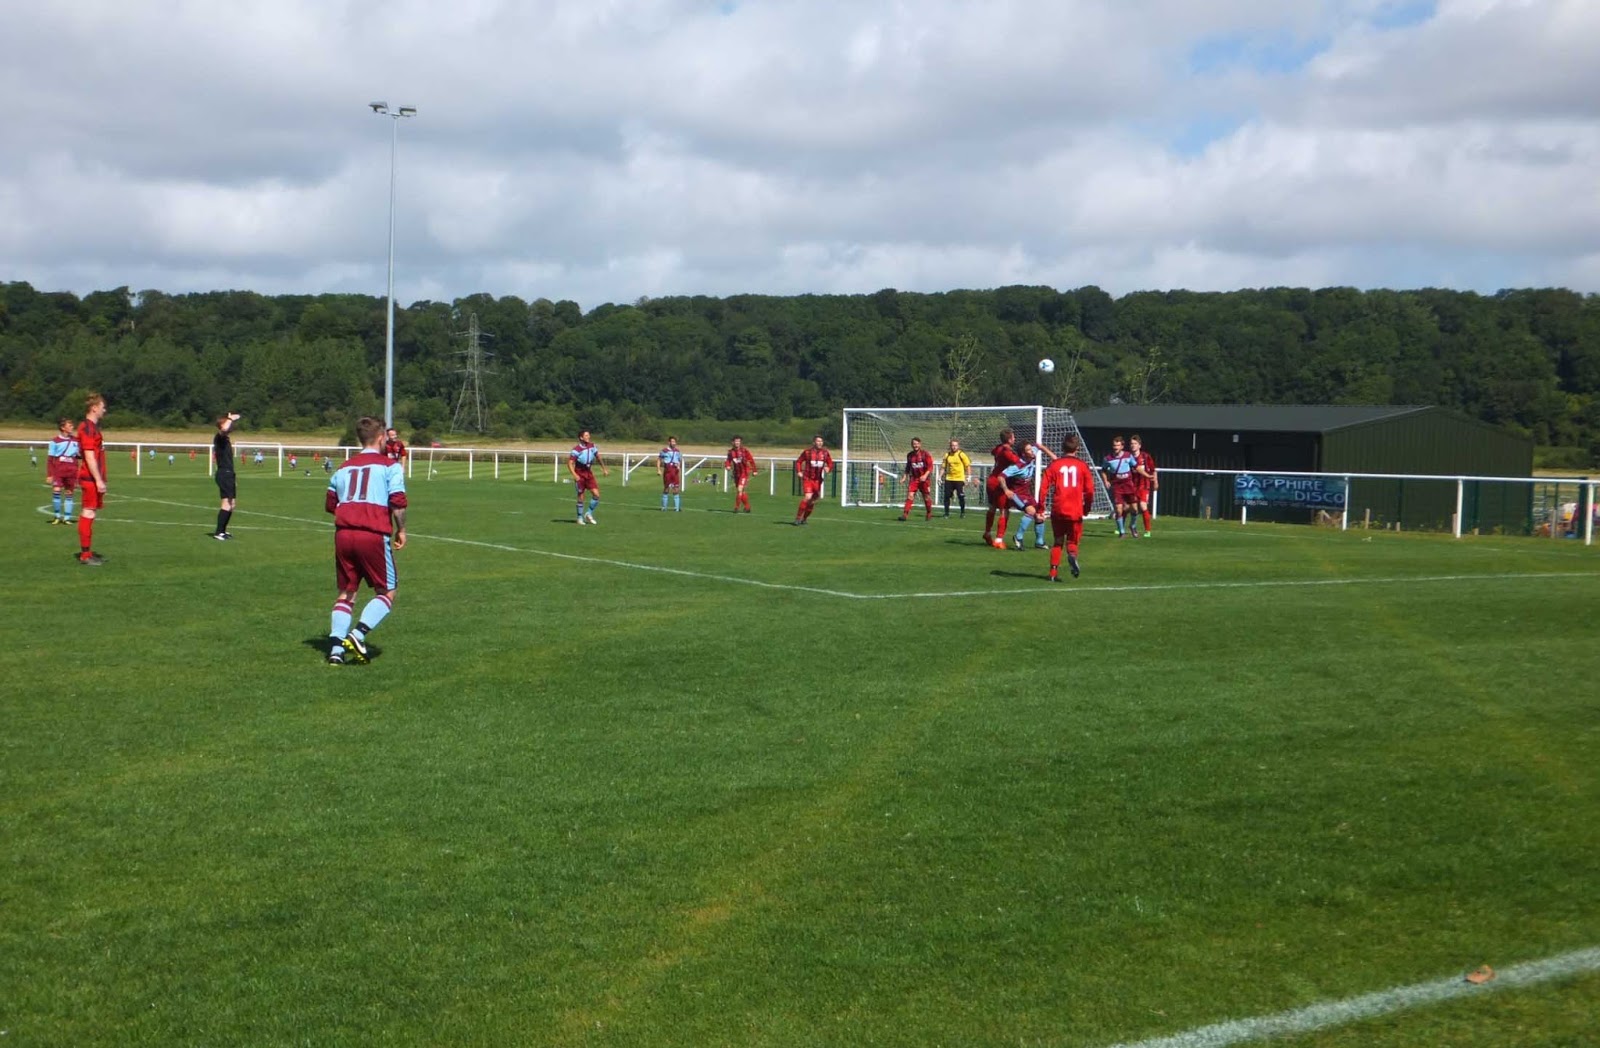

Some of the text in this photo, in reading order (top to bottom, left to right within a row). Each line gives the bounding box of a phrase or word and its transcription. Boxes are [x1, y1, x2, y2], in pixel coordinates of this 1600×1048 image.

[346, 467, 371, 501] 11
[1059, 465, 1077, 488] 11
[1236, 477, 1323, 491] SAPPHIRE
[1294, 490, 1345, 503] DISCO
